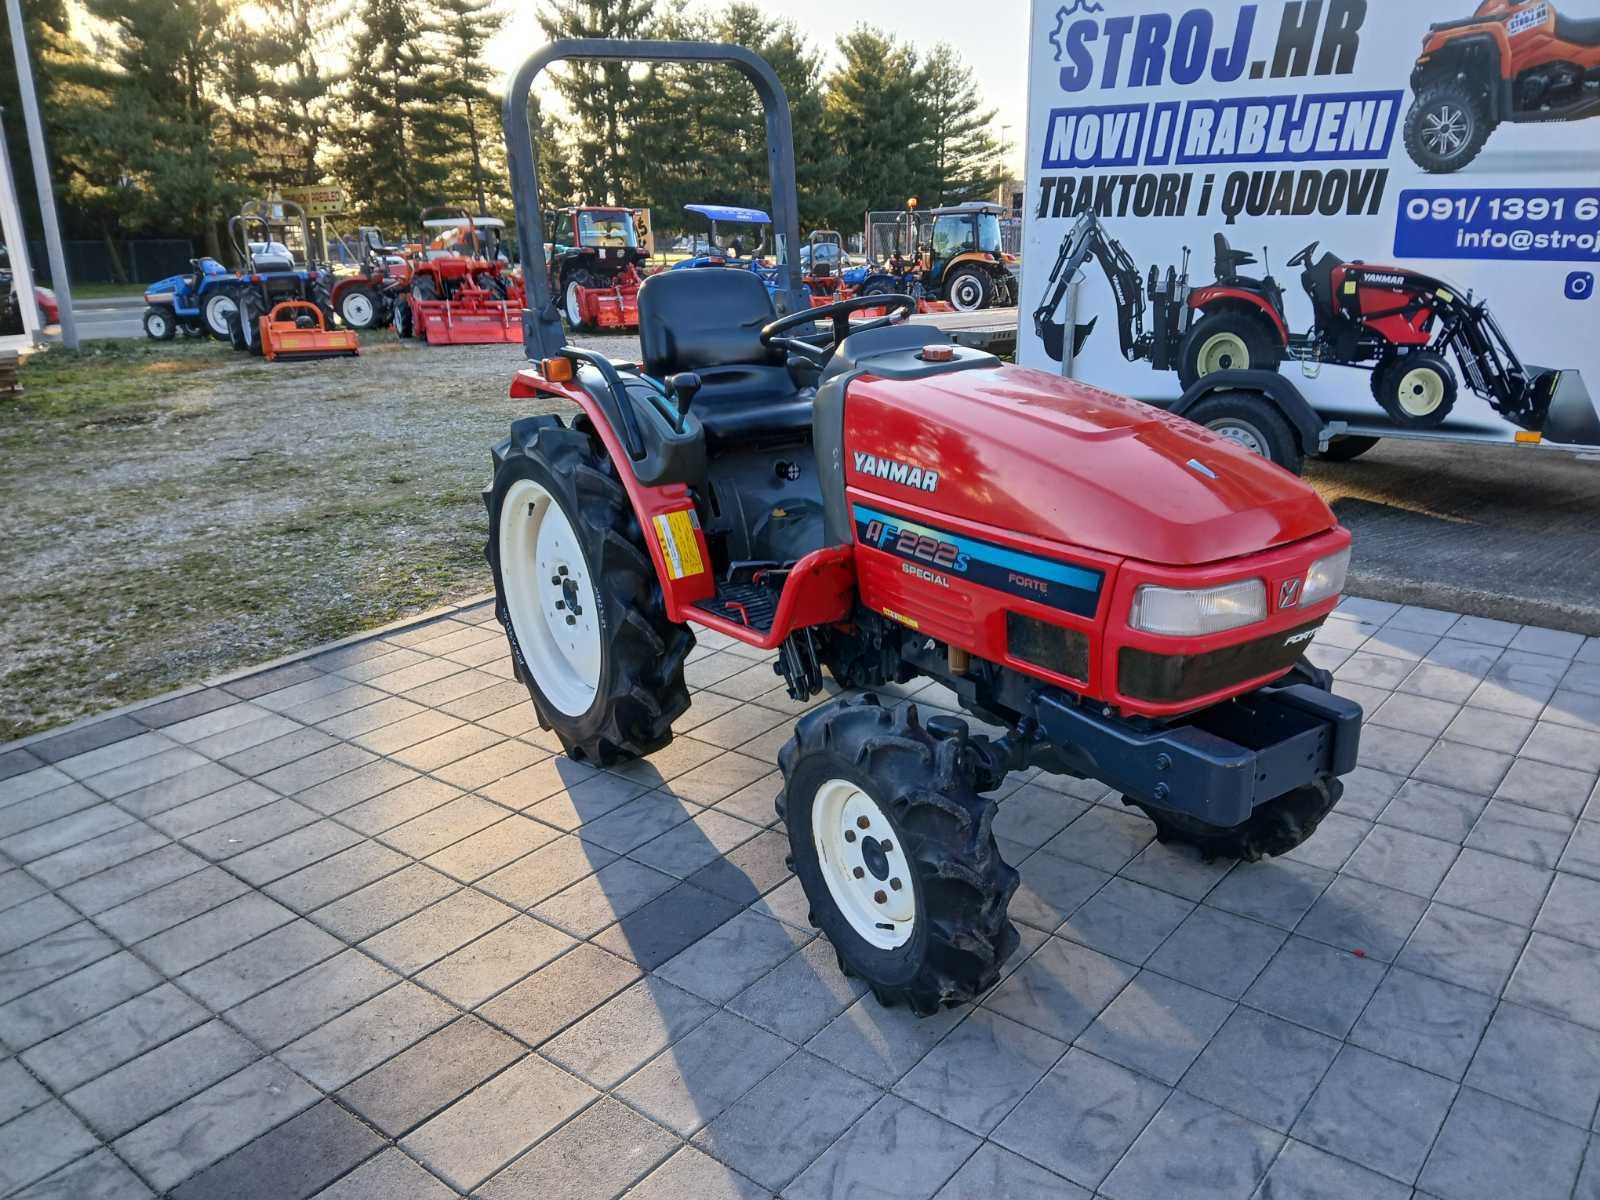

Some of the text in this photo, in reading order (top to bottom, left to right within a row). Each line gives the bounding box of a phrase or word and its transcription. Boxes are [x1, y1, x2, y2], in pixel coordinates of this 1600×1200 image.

[1059, 0, 1367, 92] STROJ.HR
[1049, 100, 1394, 162] NOVI I RABLJENI
[1038, 168, 1389, 224] TRAKTORI i QUADOVI
[1406, 196, 1600, 224] 091/ 1391 6
[1363, 272, 1405, 285] YANMAR
[853, 451, 939, 492] YANMAR
[902, 562, 950, 588] SPECIAL
[1008, 572, 1048, 593] FORTE
